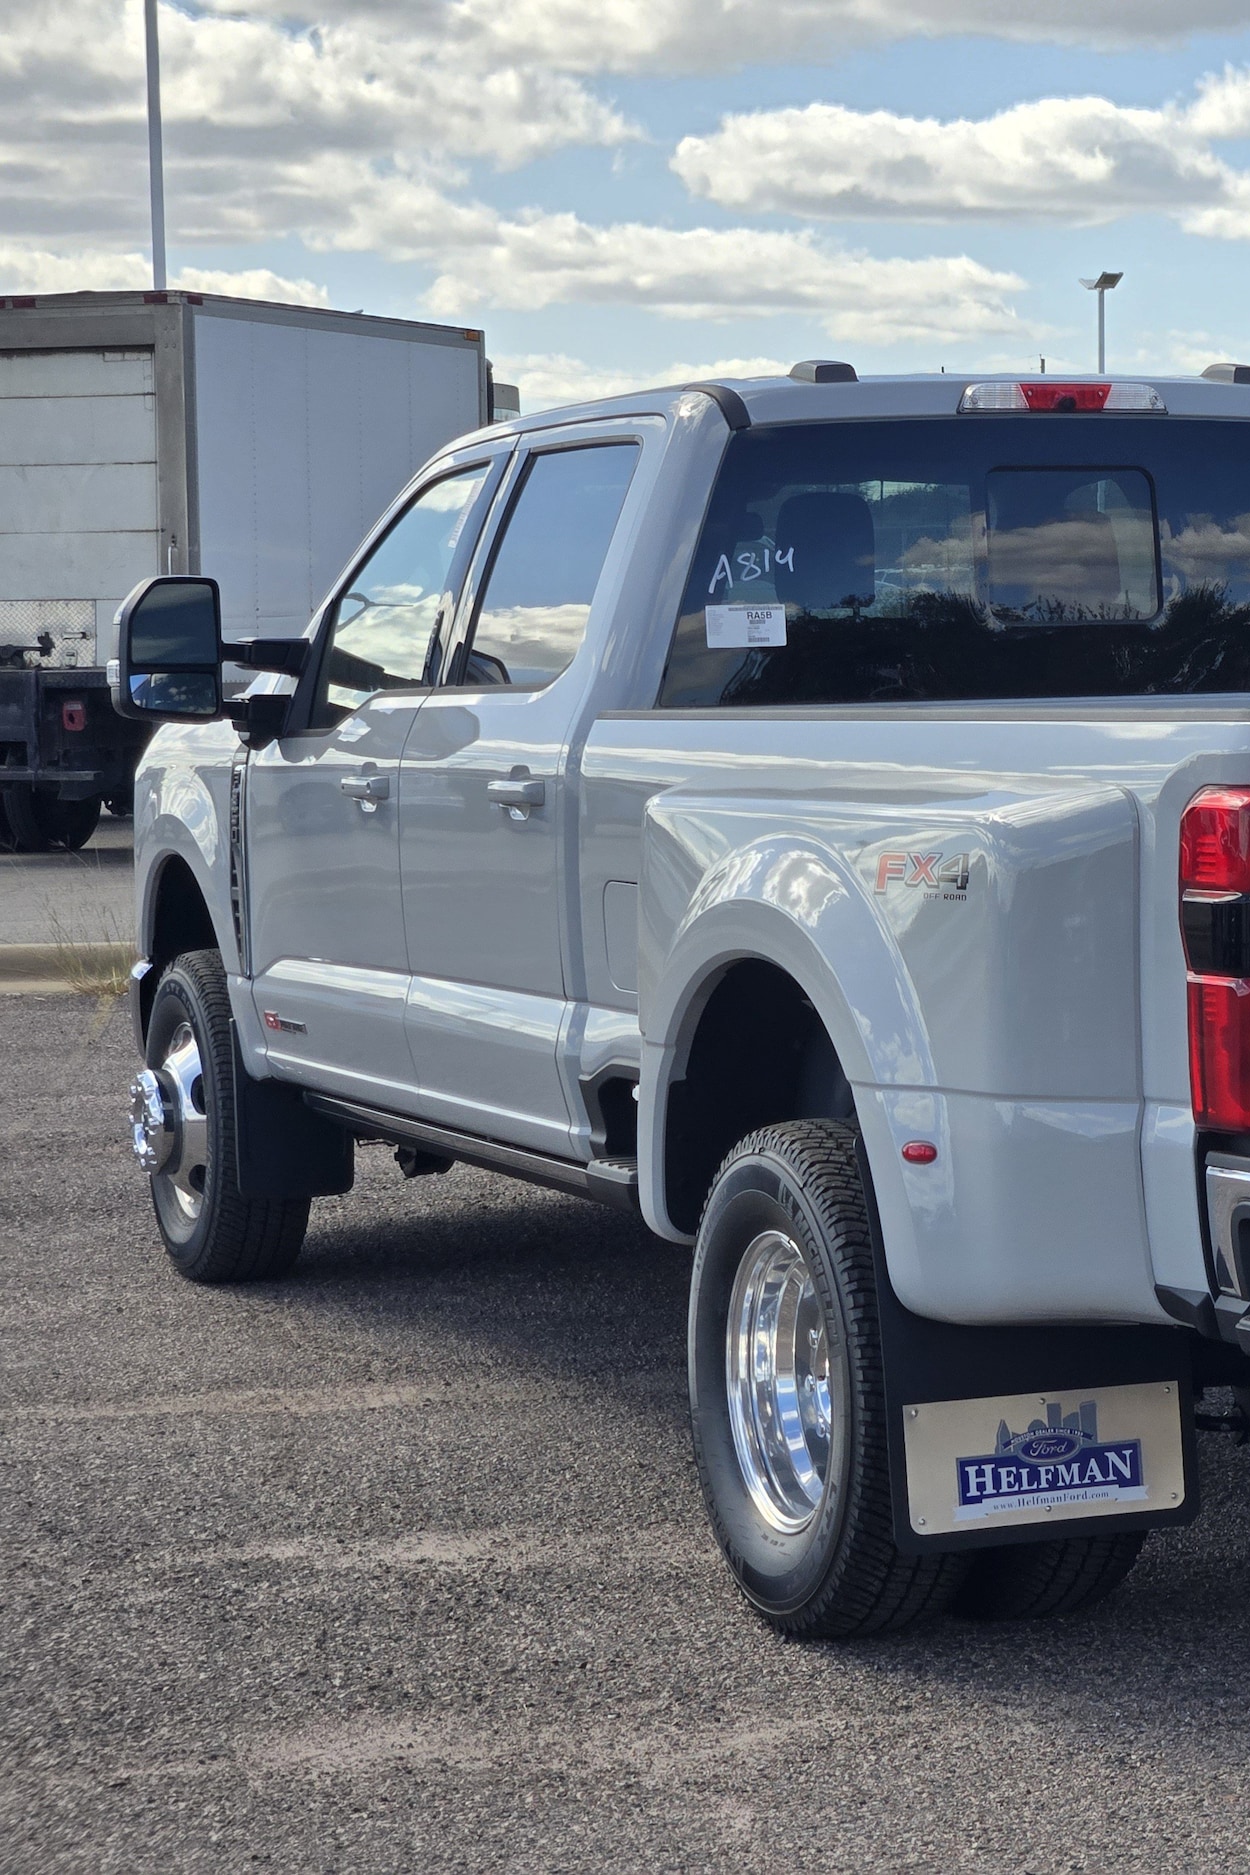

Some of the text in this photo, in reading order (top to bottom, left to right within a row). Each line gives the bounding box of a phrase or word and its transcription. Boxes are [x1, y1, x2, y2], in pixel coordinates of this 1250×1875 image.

[708, 547, 795, 594] A814
[746, 611, 773, 620] RA5B
[873, 850, 970, 895] FX4
[943, 893, 967, 901] ROAD
[1029, 1439, 1068, 1457] Ford
[964, 1449, 1134, 1498] HELFMAN
[993, 1490, 1110, 1511] www.HelfmanFord.com
